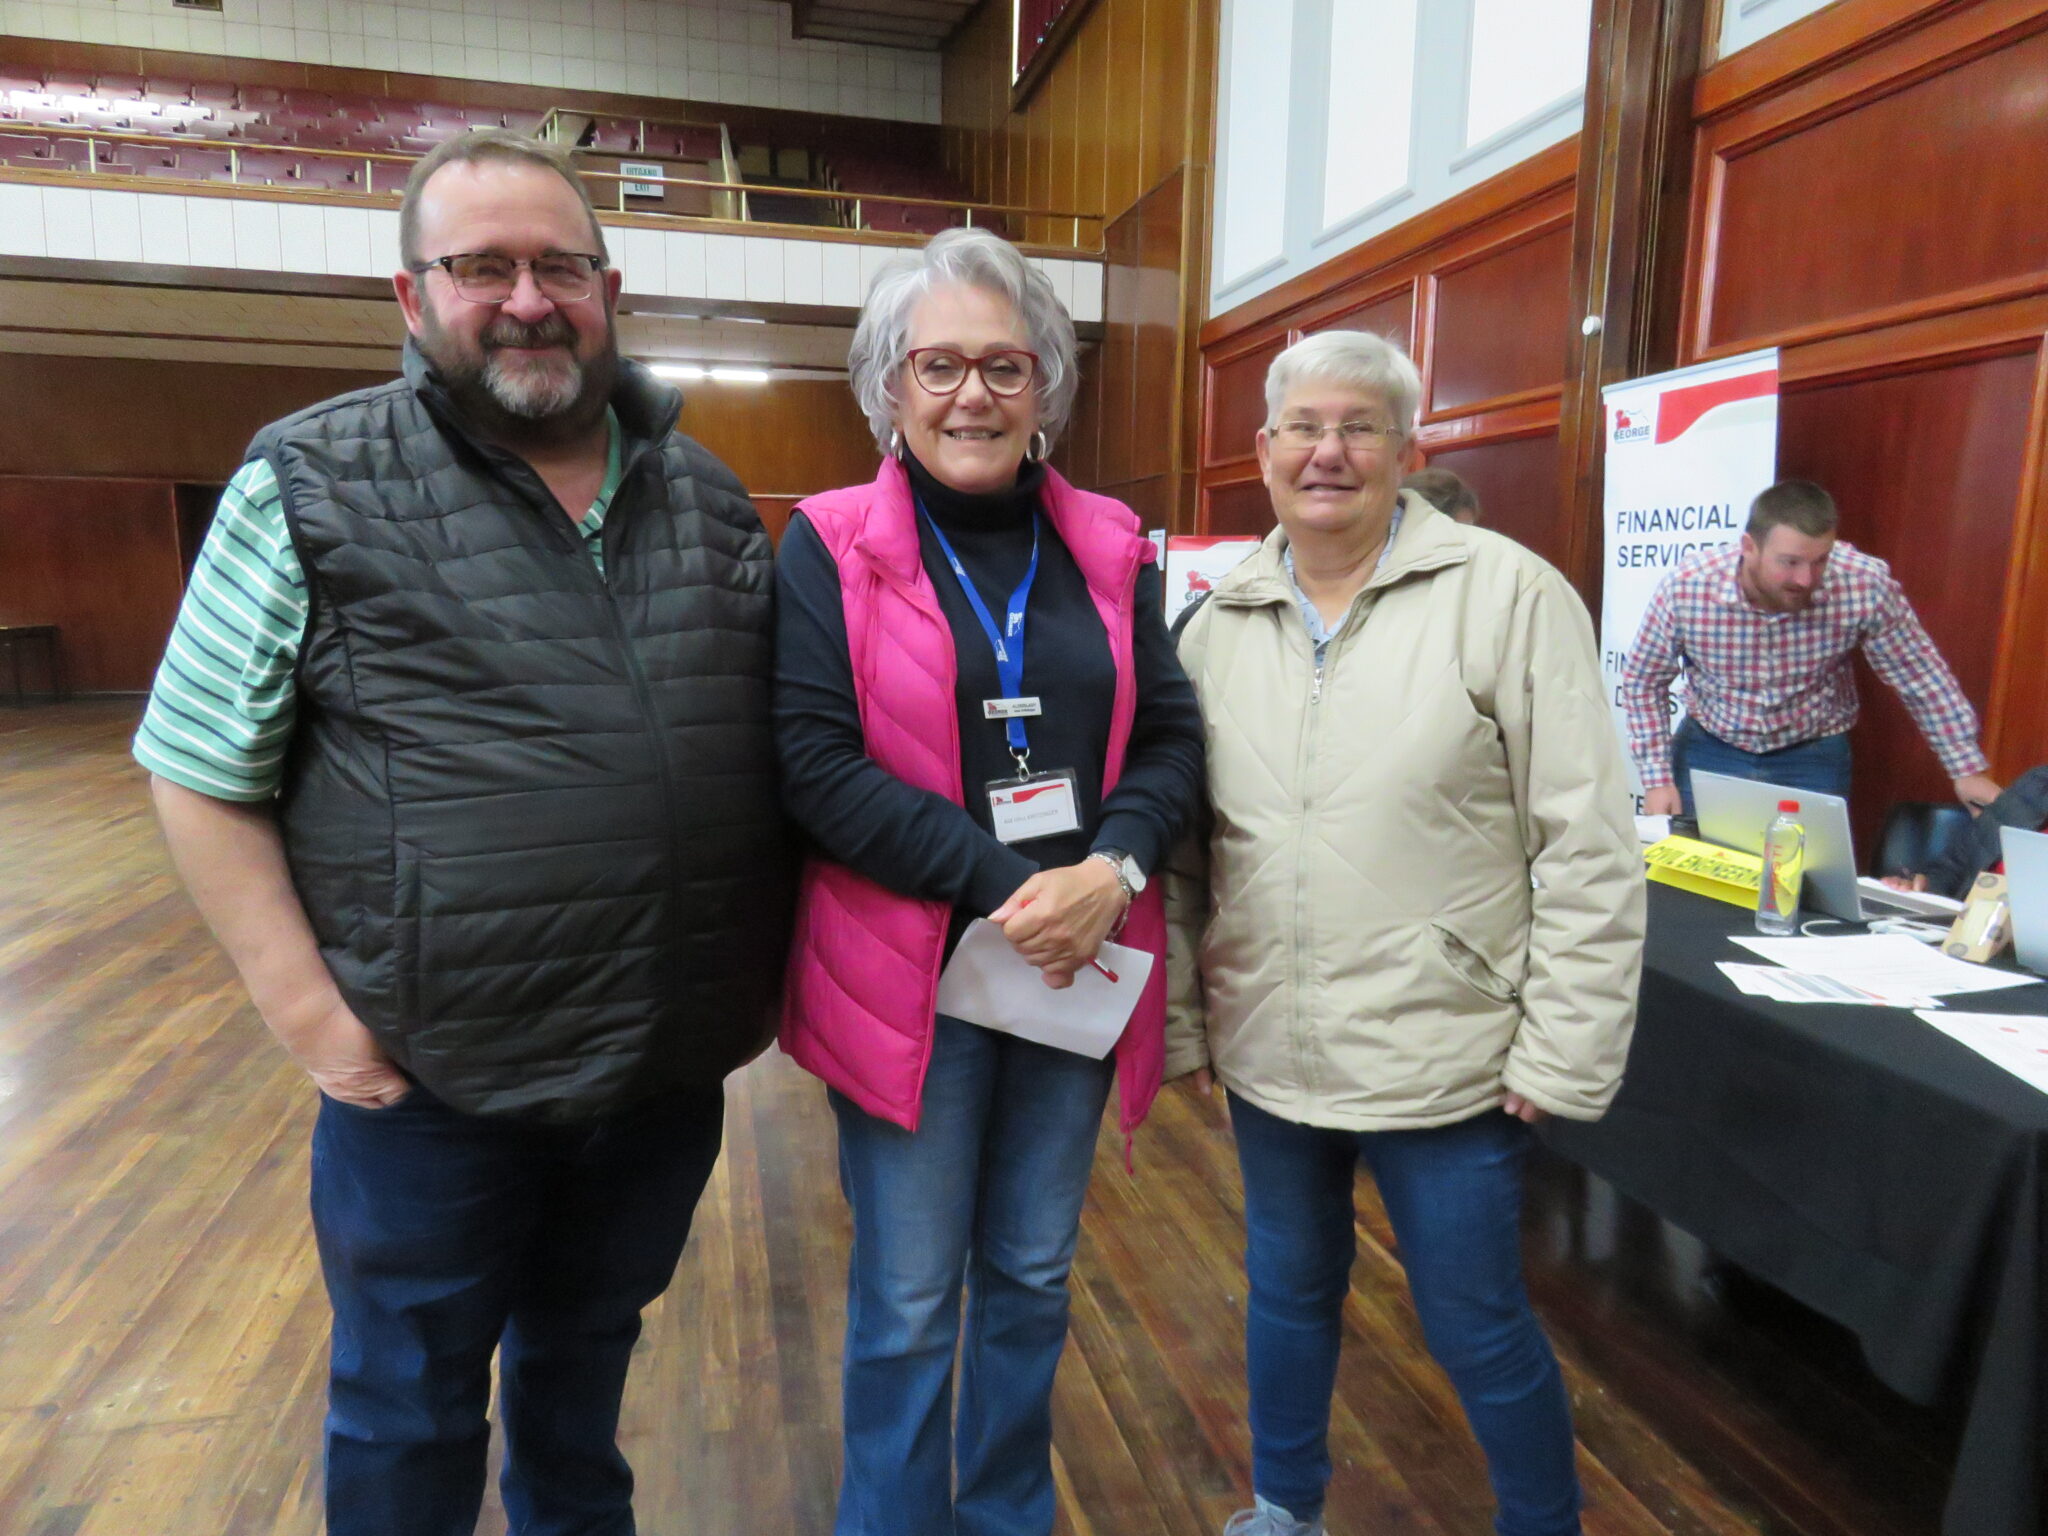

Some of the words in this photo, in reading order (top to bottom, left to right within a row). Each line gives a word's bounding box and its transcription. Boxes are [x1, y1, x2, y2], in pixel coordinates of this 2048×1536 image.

[1614, 425, 1650, 441] GEORGE
[1617, 504, 1738, 534] FINANCIAL
[1617, 542, 1729, 567] SERVIC
